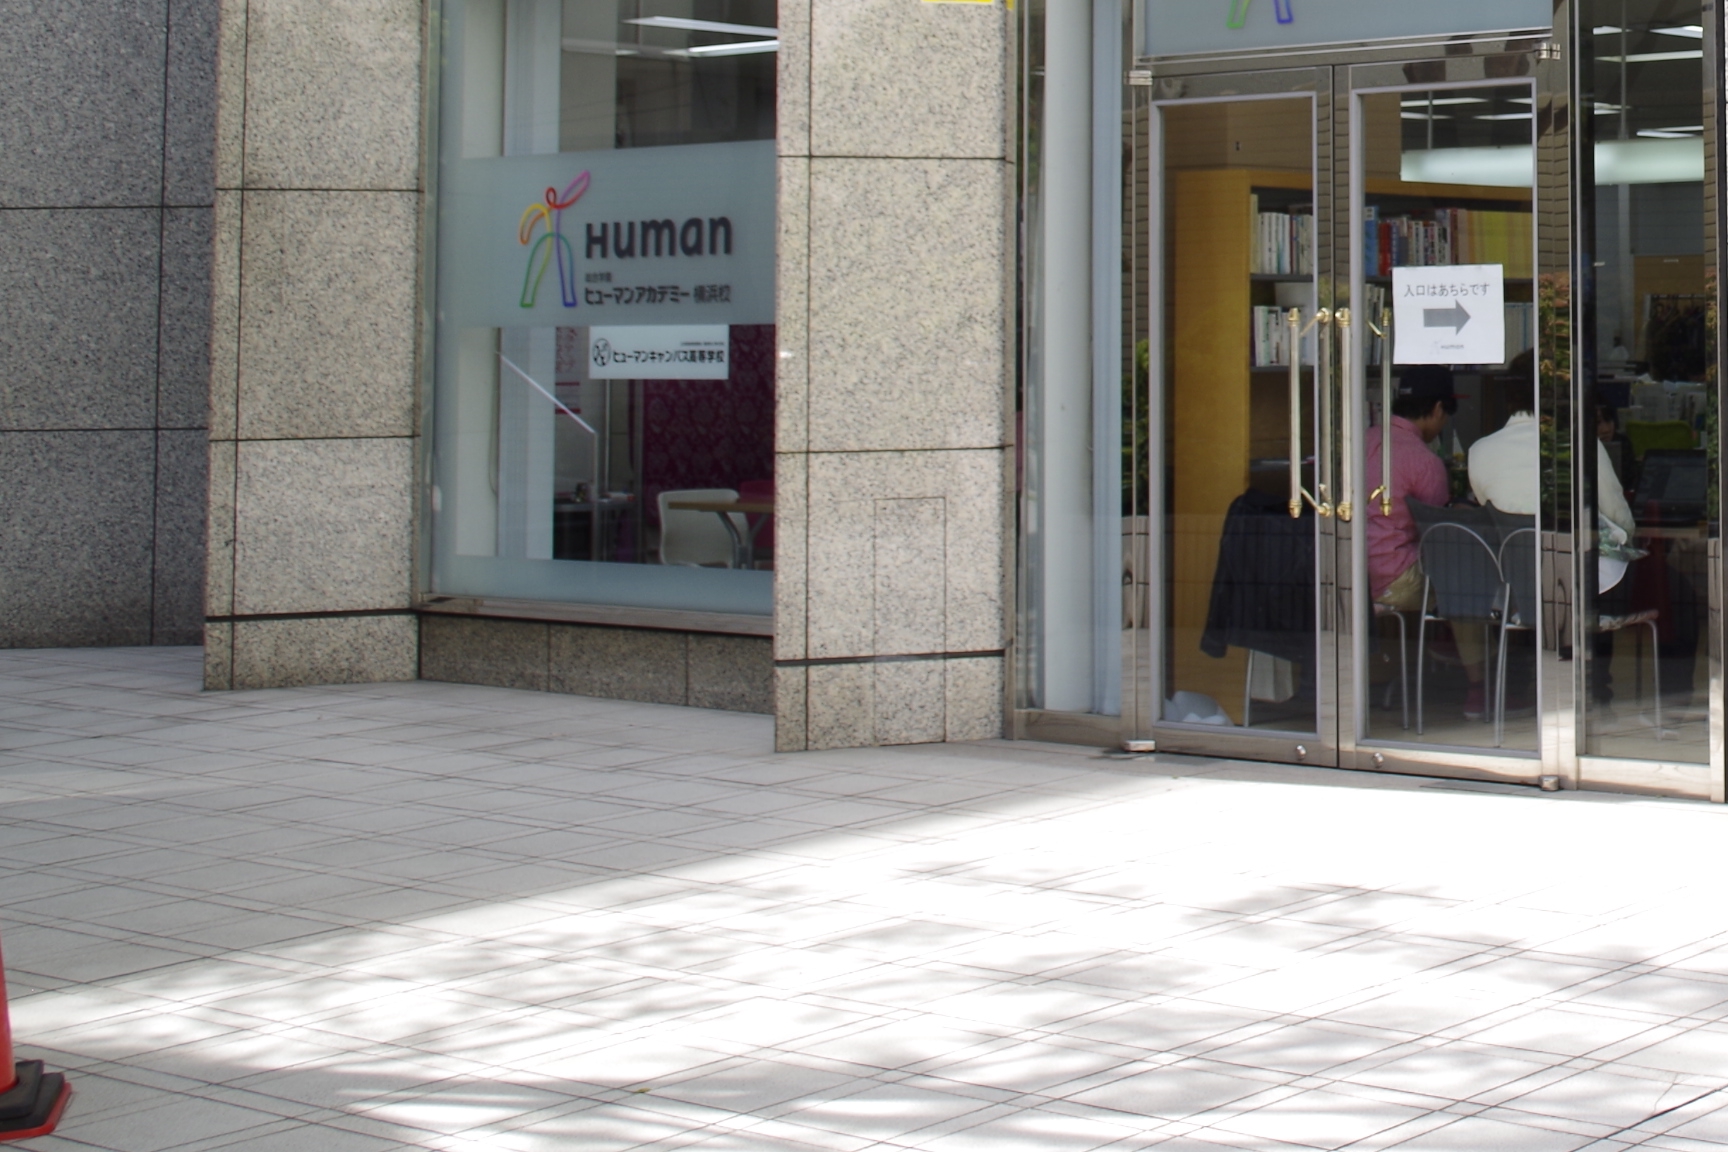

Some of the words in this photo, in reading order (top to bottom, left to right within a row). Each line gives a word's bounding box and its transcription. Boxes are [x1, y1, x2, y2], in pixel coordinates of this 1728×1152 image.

[585, 215, 733, 259] Human
[584, 285, 690, 305] ヒューマンアカデミー
[1404, 282, 1490, 297] 入口はあちらです
